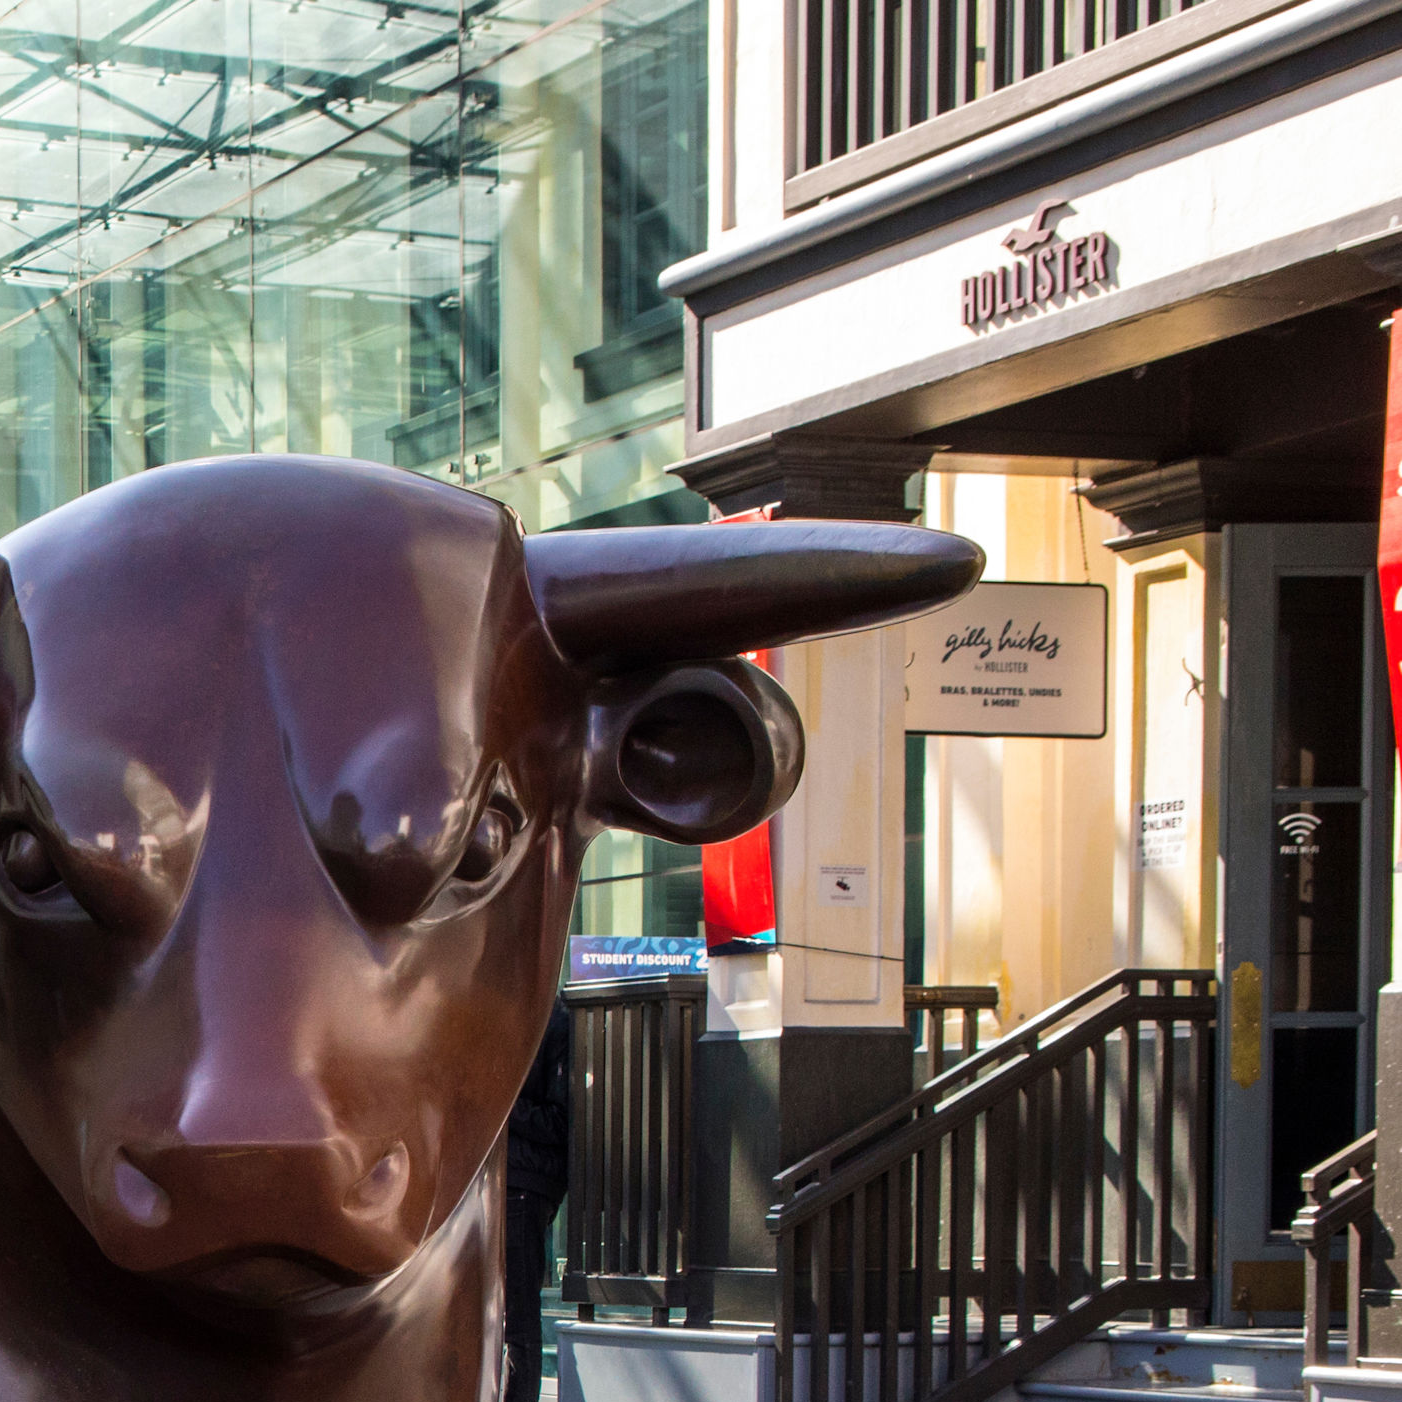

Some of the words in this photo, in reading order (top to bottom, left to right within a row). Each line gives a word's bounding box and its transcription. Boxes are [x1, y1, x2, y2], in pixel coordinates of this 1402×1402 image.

[961, 231, 1107, 326] HOLLISTER
[941, 625, 993, 663] gilly
[997, 619, 1061, 659] hicks
[984, 661, 1029, 673] HOLLISTER
[1028, 687, 1063, 698] UNDIES
[581, 953, 635, 965] STUDENT
[636, 954, 692, 966] DISCOUNT
